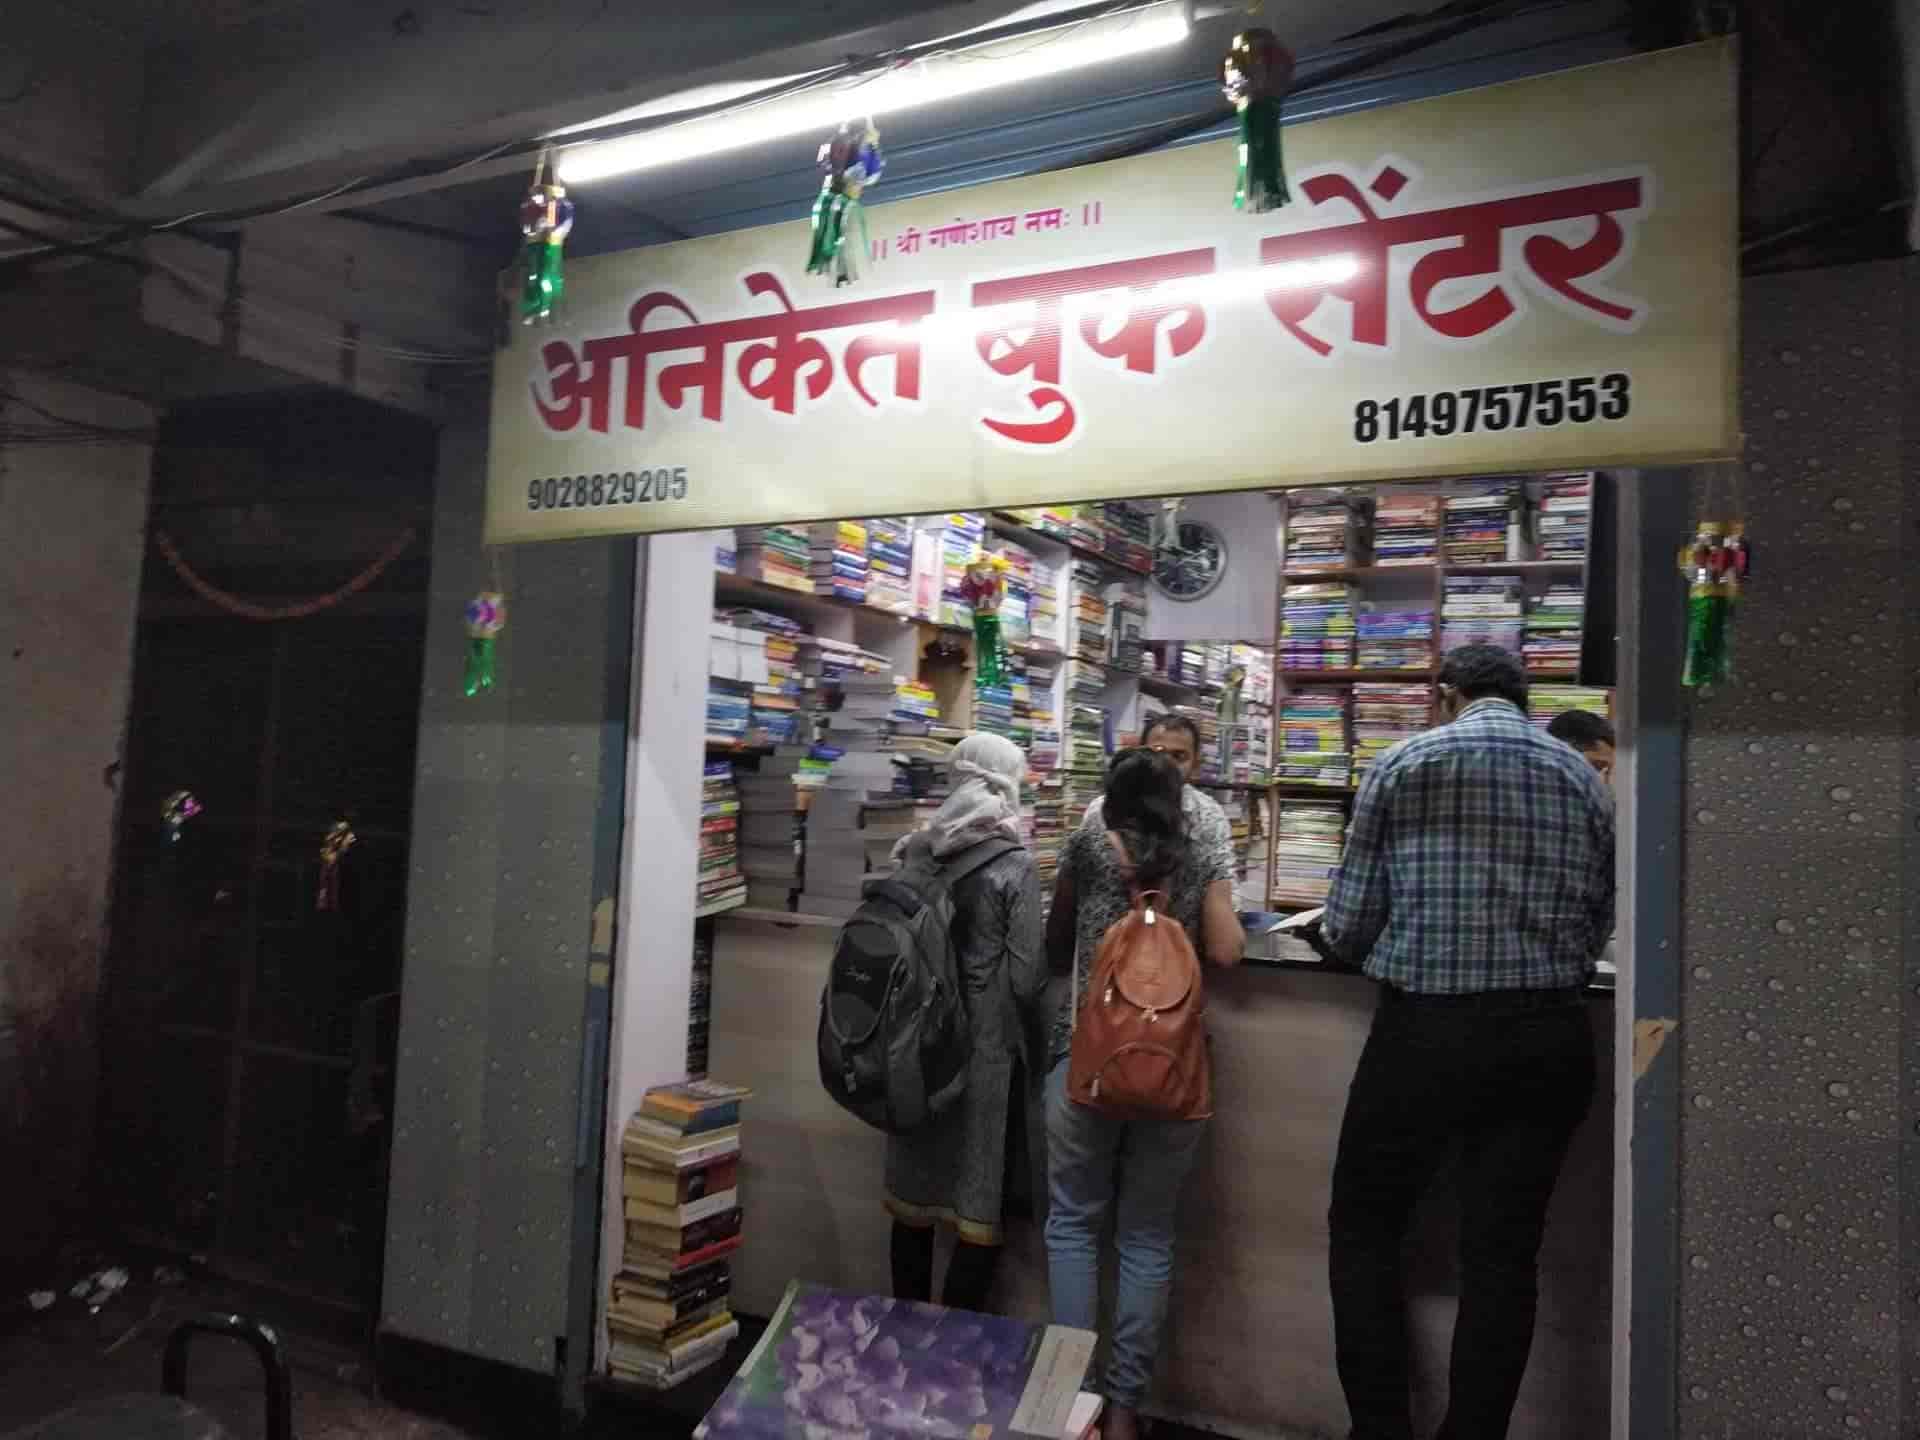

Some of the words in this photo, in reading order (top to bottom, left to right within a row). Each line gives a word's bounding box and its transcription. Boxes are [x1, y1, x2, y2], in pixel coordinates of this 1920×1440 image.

[928, 216, 1018, 249] गणेशाय
[532, 271, 936, 433] अनिकेत
[972, 247, 1216, 444] बुक
[1260, 165, 1641, 357] सेंटर
[1355, 373, 1630, 443] 8149757553
[528, 467, 687, 511] 9028829205
